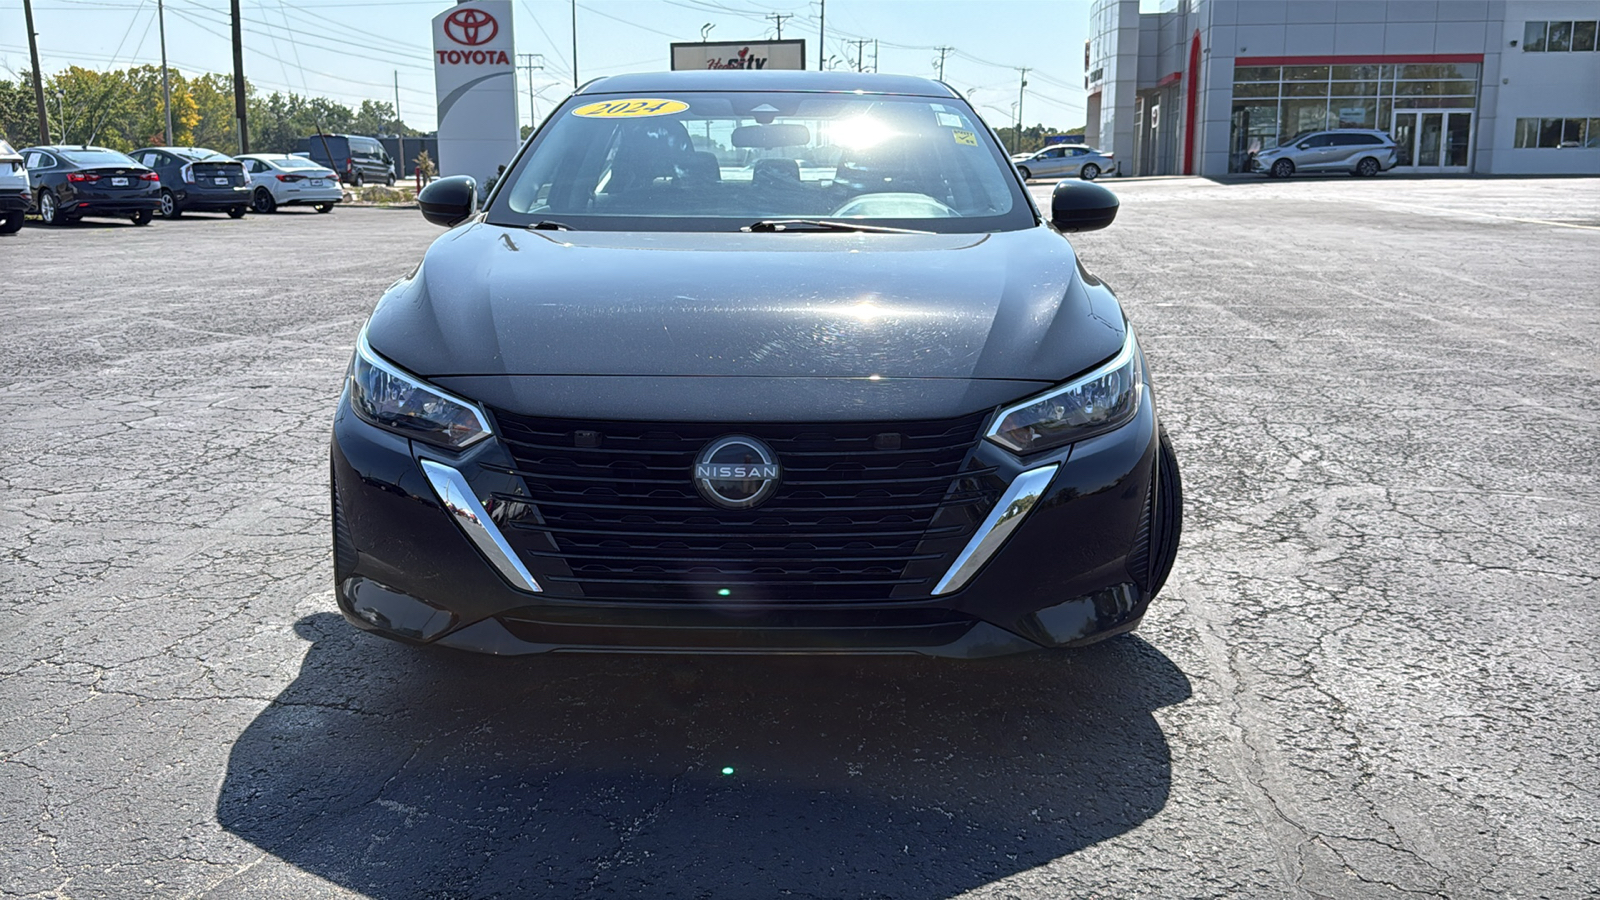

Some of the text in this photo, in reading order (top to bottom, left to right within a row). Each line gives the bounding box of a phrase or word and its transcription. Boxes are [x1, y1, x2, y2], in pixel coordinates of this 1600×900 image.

[436, 50, 510, 65] TOYOTA
[585, 101, 670, 115] 2024
[698, 466, 776, 478] NISSAN
